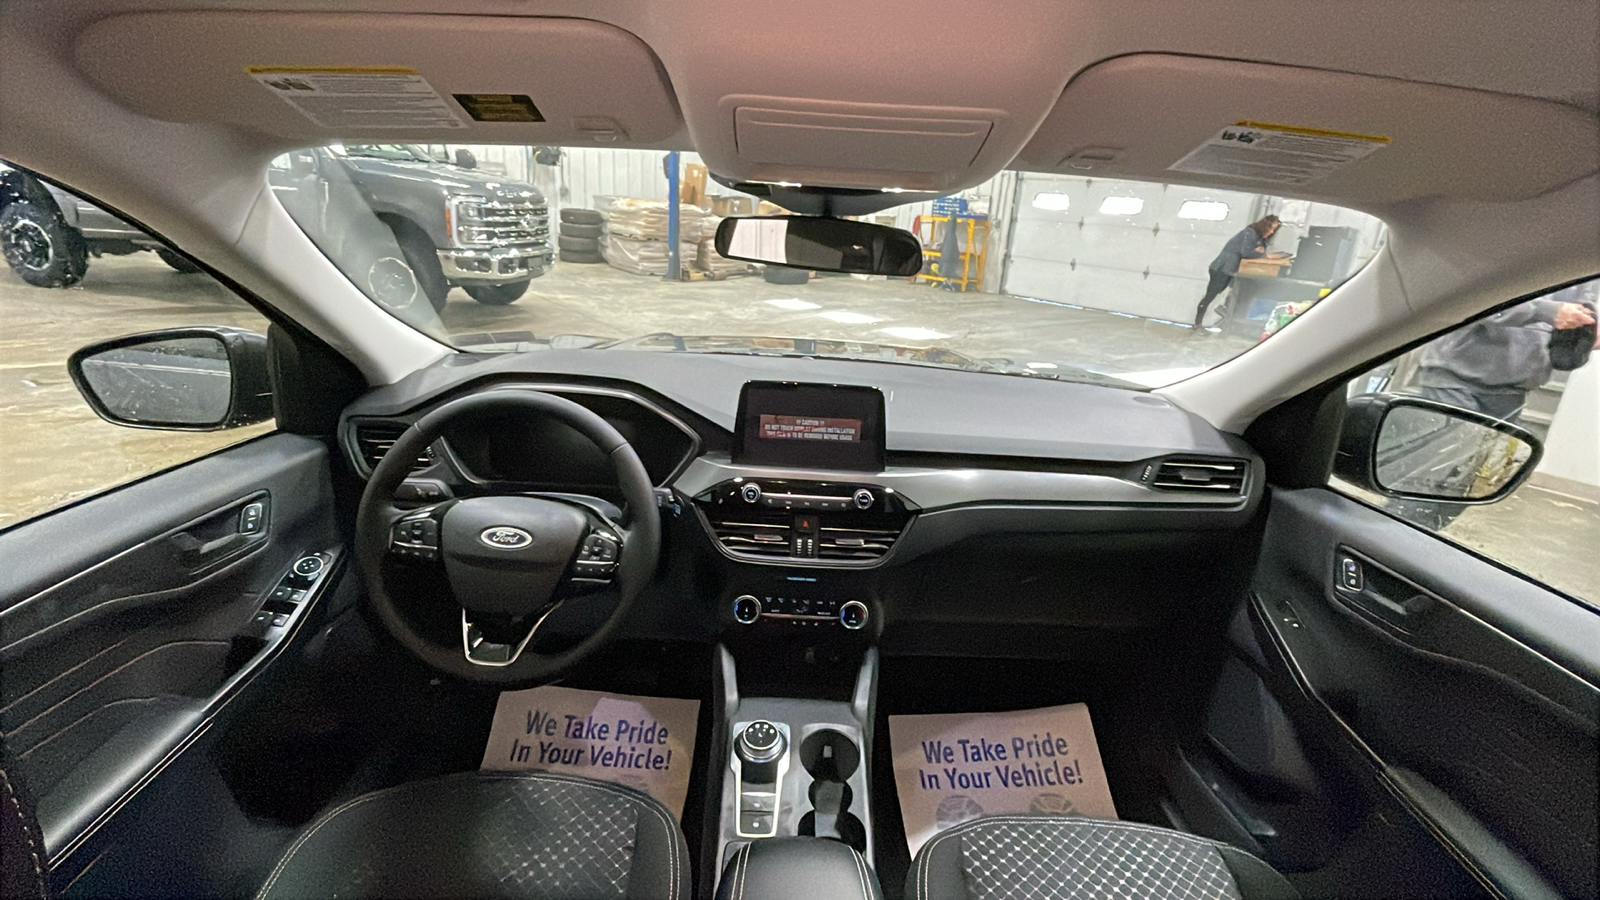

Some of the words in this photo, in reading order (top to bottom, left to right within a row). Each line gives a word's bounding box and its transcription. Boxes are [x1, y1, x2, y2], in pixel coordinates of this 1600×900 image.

[492, 530, 520, 543] Ford
[526, 710, 557, 737] We
[564, 714, 610, 741] Take
[615, 719, 669, 745] Pride
[509, 738, 531, 763] In
[538, 741, 585, 766] Your
[590, 745, 672, 770] Vehicle!
[921, 740, 954, 764] We
[957, 738, 1008, 762] Take
[1011, 732, 1068, 760] Pride
[918, 768, 941, 790] In
[943, 767, 992, 789] Your
[994, 759, 1084, 788] Vehicle!
